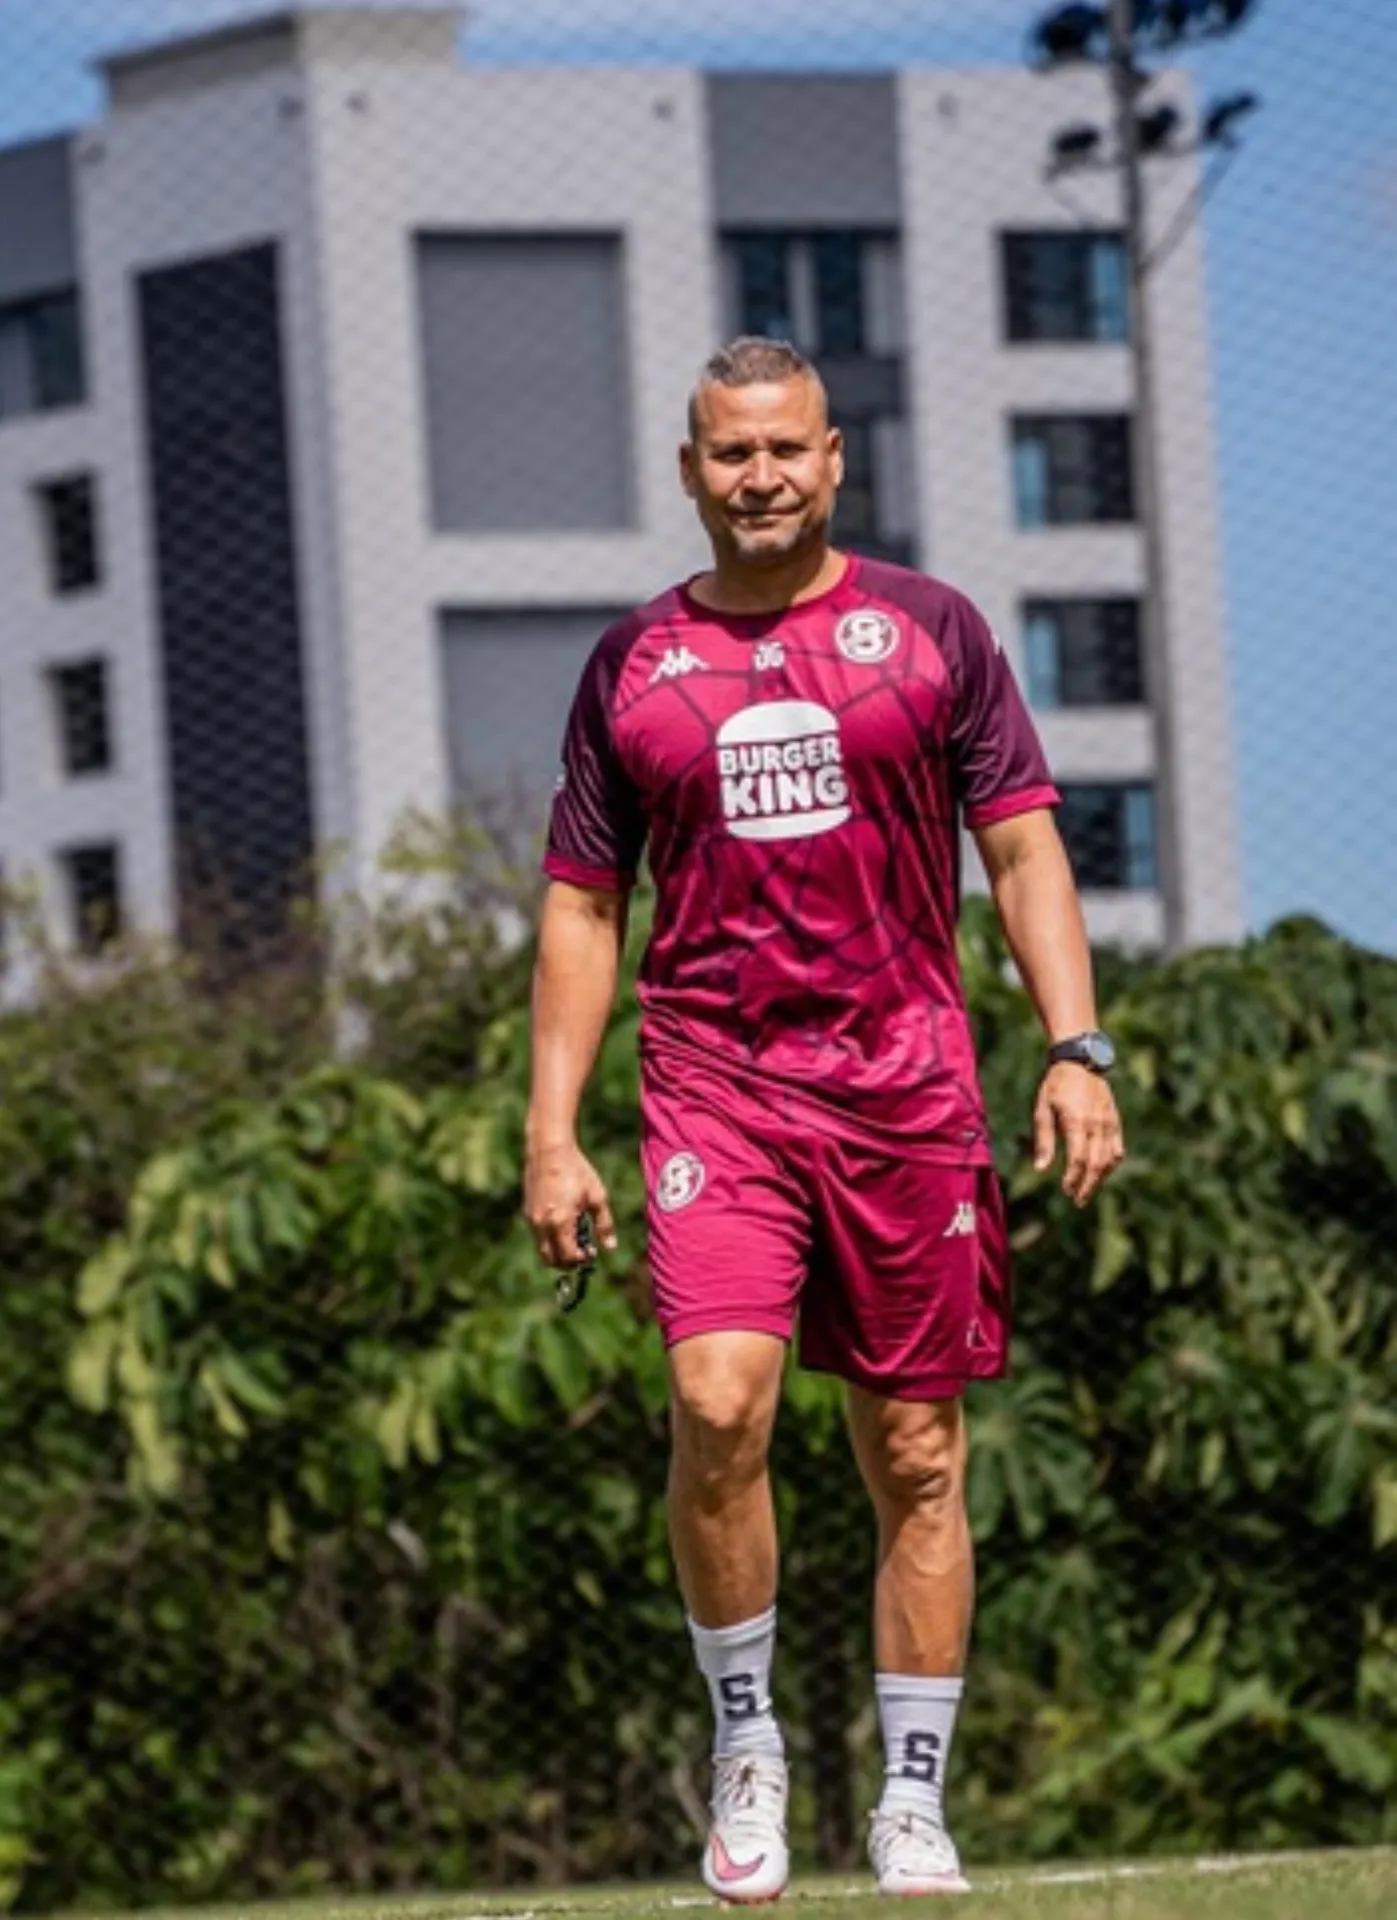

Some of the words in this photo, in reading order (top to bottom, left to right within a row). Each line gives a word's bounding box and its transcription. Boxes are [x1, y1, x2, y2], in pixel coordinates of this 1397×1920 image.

[719, 736, 842, 775] BURGER
[721, 766, 848, 818] KING
[720, 1673, 757, 1721] S
[903, 1731, 940, 1782] S
